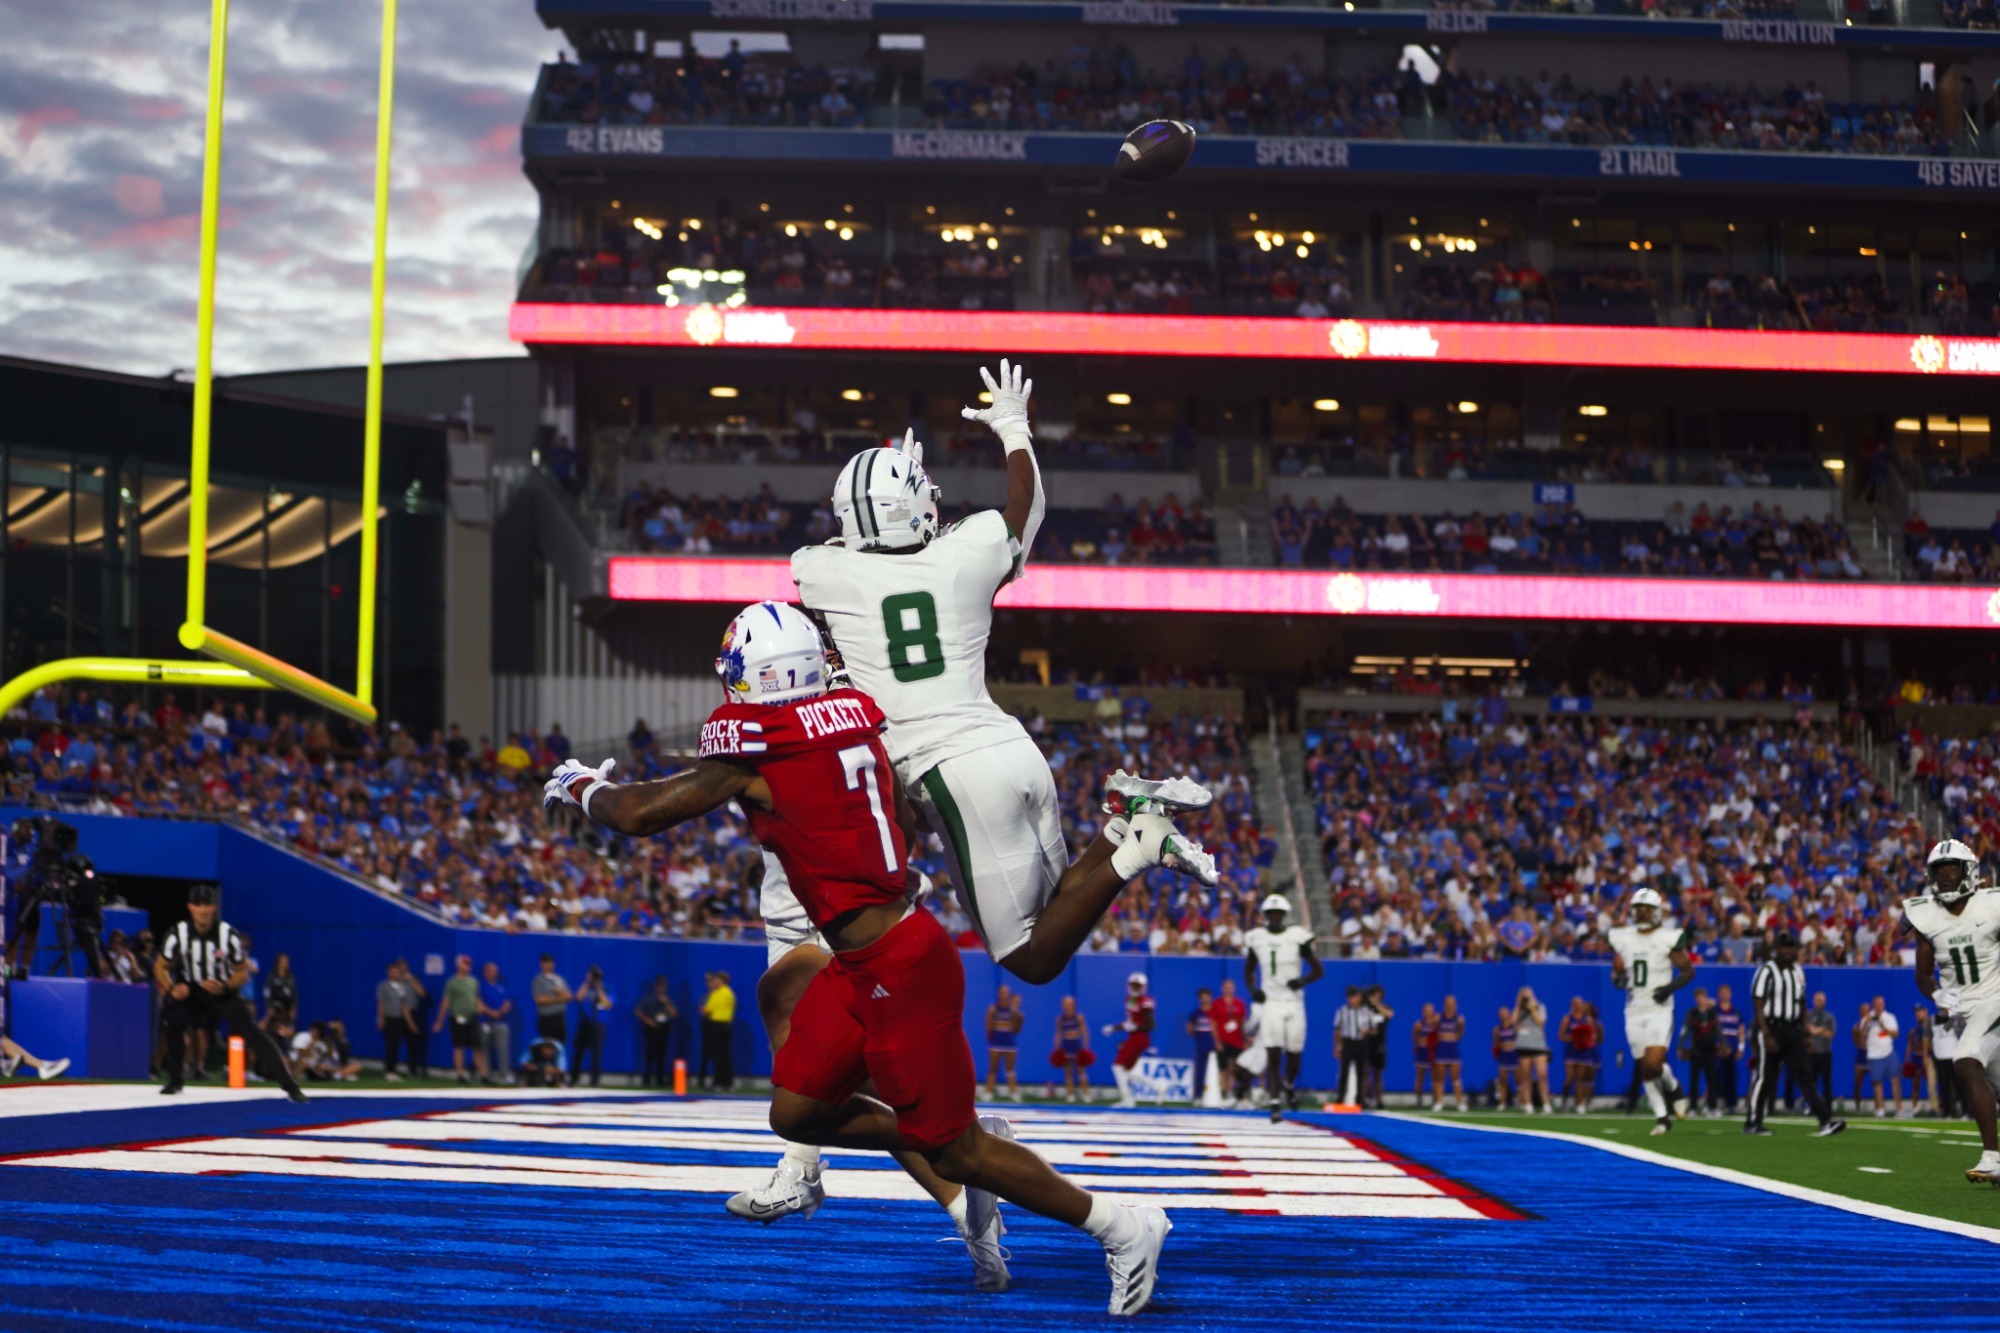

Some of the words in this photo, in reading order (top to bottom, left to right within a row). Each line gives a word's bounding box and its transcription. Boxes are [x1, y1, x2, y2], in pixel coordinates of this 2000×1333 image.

[1427, 11, 1488, 32] REICH
[566, 128, 594, 153] 42
[598, 128, 663, 154] EVANS
[892, 131, 1026, 159] McCORMACK
[1256, 140, 1349, 167] SPENCER
[1600, 150, 1623, 175] 21
[1629, 151, 1681, 177] HADL
[1918, 160, 1944, 186] 48
[1949, 162, 2000, 188] SAYE
[880, 590, 946, 684] 8
[787, 668, 795, 688] 7
[701, 719, 742, 742] ROCK
[796, 698, 872, 740] PICKETT
[701, 737, 740, 757] CHALK
[837, 744, 899, 873] 7
[1270, 950, 1277, 977] 1
[1633, 960, 1648, 988] 0
[1949, 945, 1980, 986] 11
